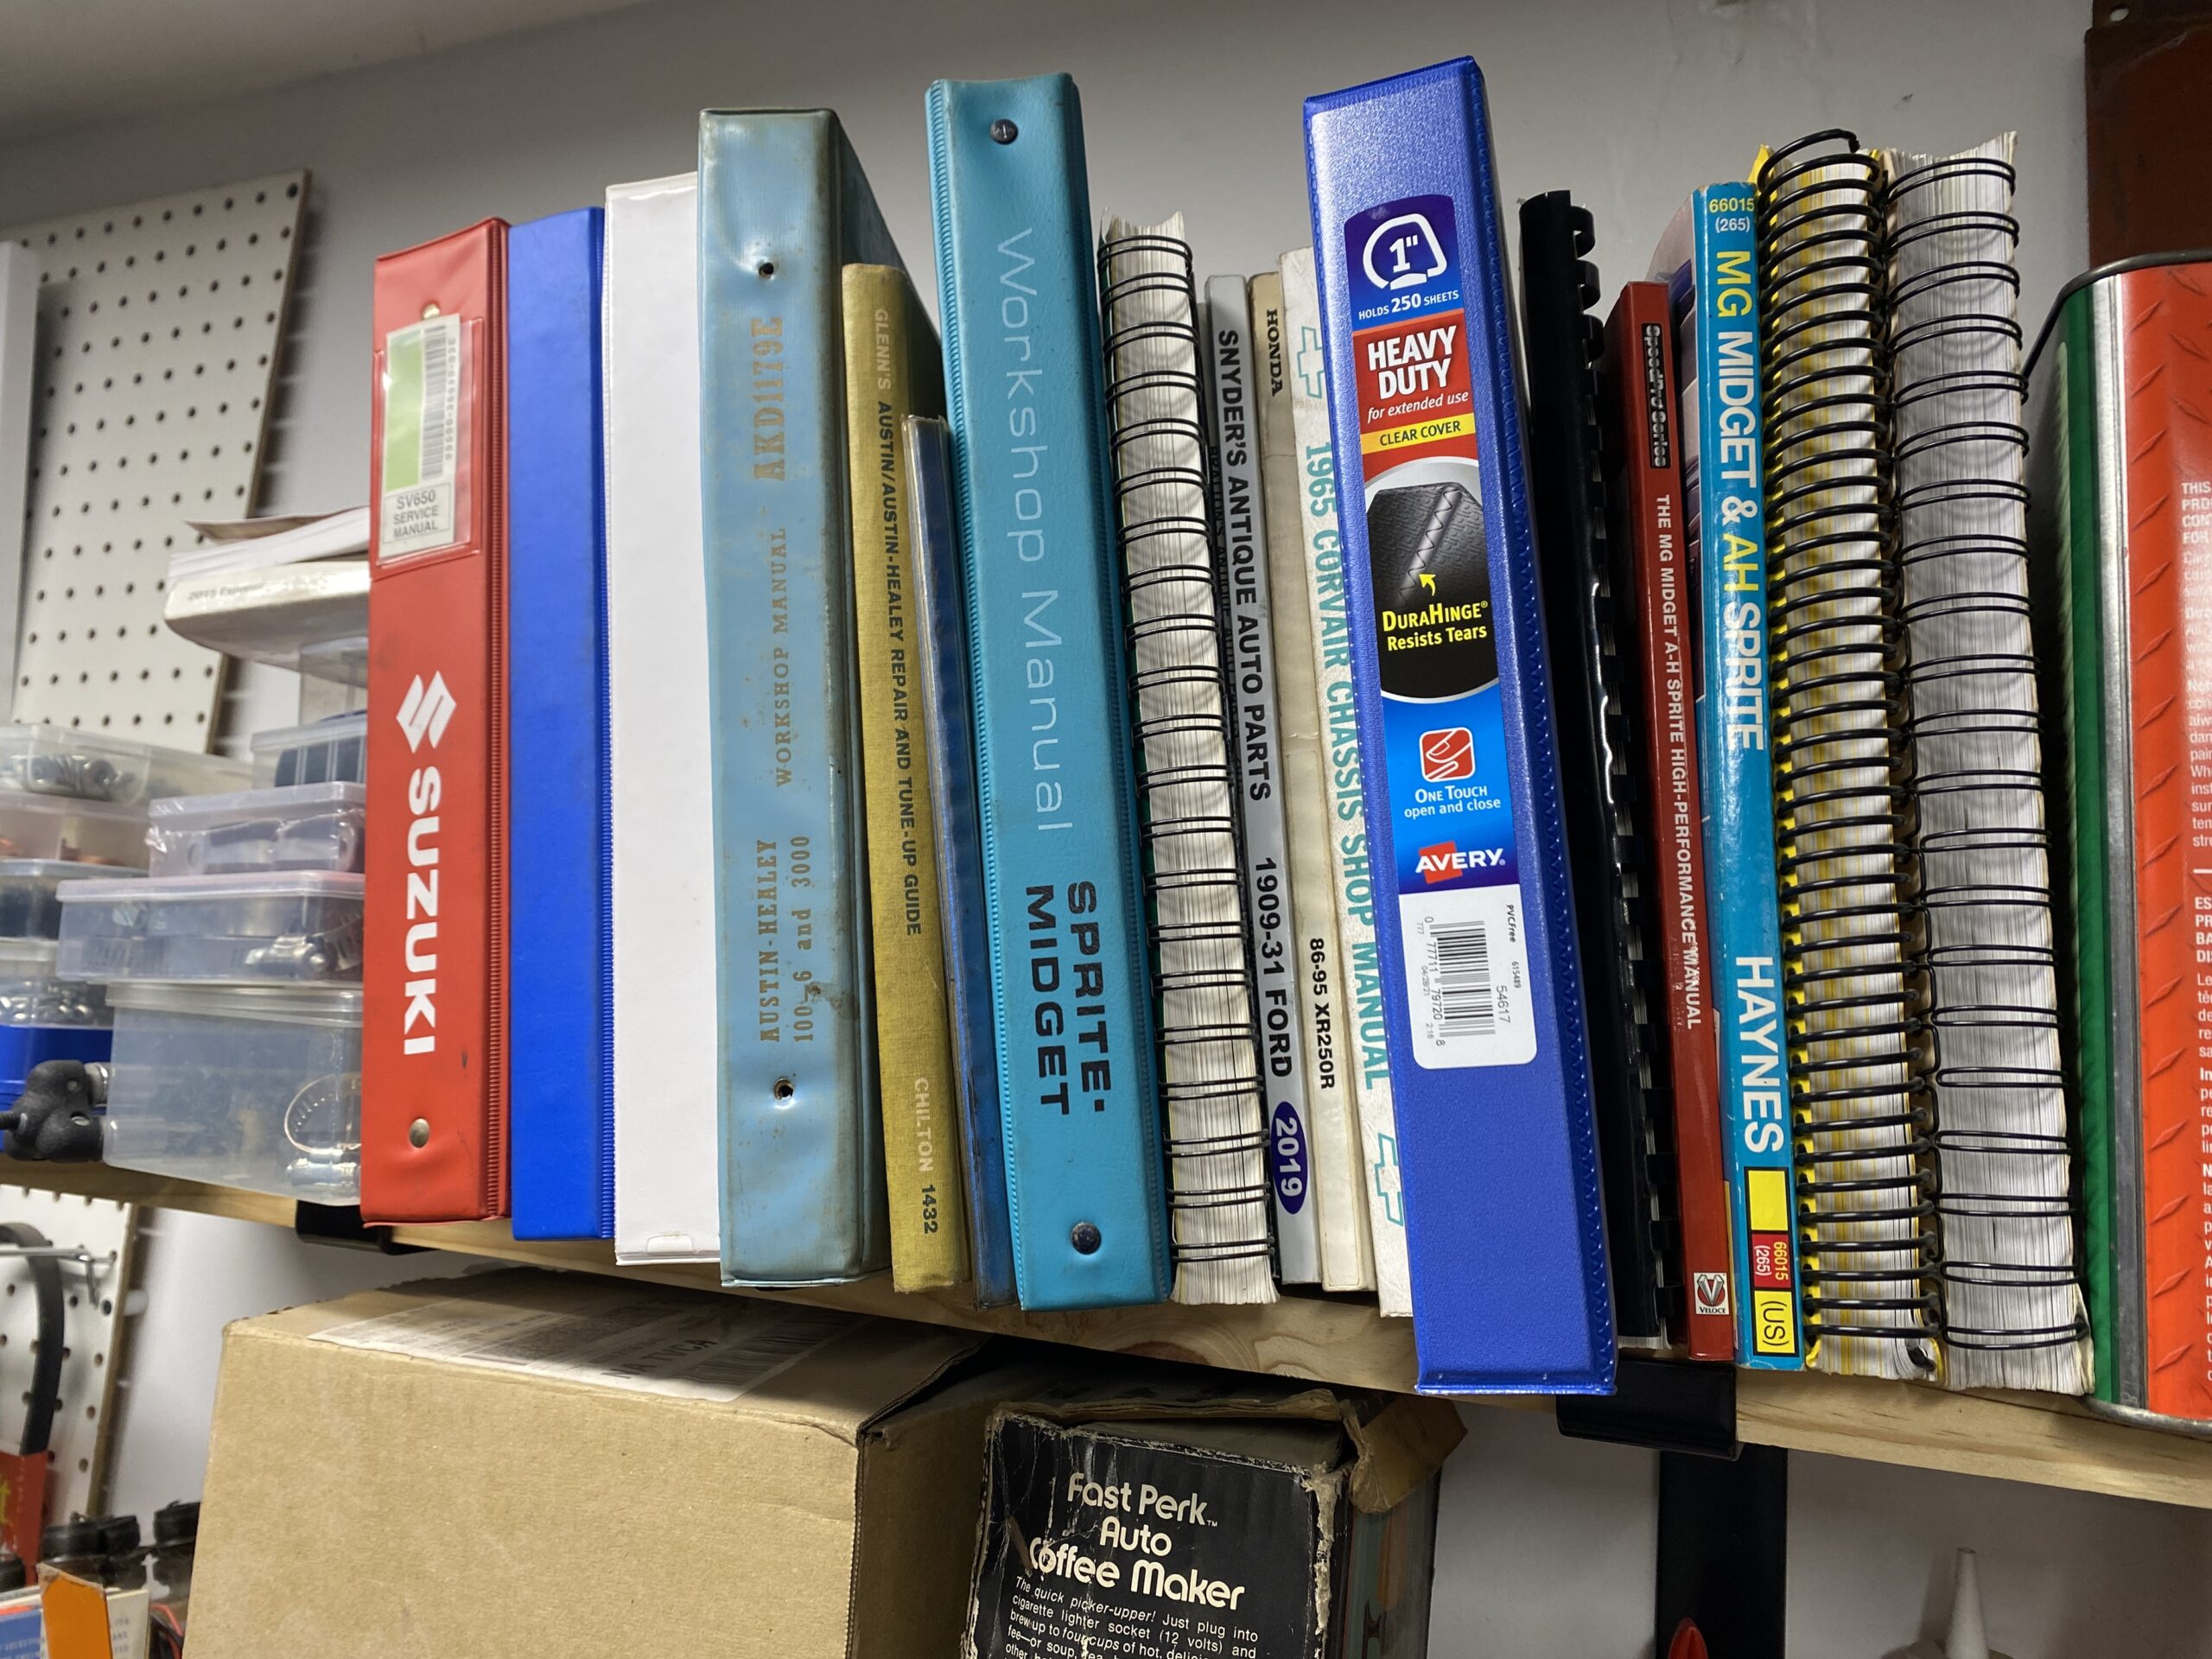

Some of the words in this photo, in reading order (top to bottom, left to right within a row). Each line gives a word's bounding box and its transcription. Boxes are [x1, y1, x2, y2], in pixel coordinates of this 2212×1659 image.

[1709, 197, 1755, 213] 66015
[1715, 217, 1750, 233] (265)
[1359, 306, 1389, 321] HOLDS
[1391, 293, 1421, 313] 250
[1424, 289, 1459, 306] SHEETS
[1716, 250, 1753, 319] MG
[874, 308, 892, 391] GLENN'S
[1266, 308, 1283, 397] HONDA
[1368, 325, 1457, 371] HEAVY
[1378, 358, 1451, 400] DUTY
[750, 316, 786, 482] AKD1179E
[998, 227, 1049, 563] Workshop
[1217, 329, 1247, 467] SNYDER'S
[1367, 406, 1385, 424] for
[1388, 393, 1443, 416] extended
[1446, 391, 1469, 406] use
[1718, 331, 1757, 489] MIDGET
[1380, 429, 1418, 447] CLEAR
[1421, 420, 1461, 438] COVER
[396, 489, 436, 510] SV650
[1306, 441, 1338, 518] 1965
[1656, 494, 1672, 529] THE
[1720, 495, 1758, 526] &
[2181, 480, 2211, 495] THIS
[393, 505, 439, 525] SERVICE
[394, 519, 438, 539] MANUAL
[878, 401, 905, 642] AUSTIN/AUSTIN-HEALEY
[1228, 475, 1257, 606] ANTIQUE
[1659, 534, 1674, 563] MG
[769, 527, 791, 635] MANUAL
[1722, 533, 1759, 592] AH
[1313, 529, 1350, 670] CORVAIR
[1660, 568, 1678, 637] MIDGET
[1236, 614, 1263, 695] AUTO
[1387, 632, 1443, 652] Resists
[1446, 624, 1488, 643] Tears
[1664, 641, 1680, 674] A-H
[890, 649, 908, 721] REPAIR
[1021, 589, 1074, 831] Manual
[1724, 601, 1765, 752] SPRITE
[773, 646, 793, 788] WORKSHOP
[1667, 677, 1684, 744] SPRITE
[894, 728, 912, 771] AND
[1244, 703, 1271, 802] PARTS
[1326, 680, 1364, 822] CHASSIS
[898, 777, 918, 867] TUNE-UP
[1404, 805, 1435, 820] open
[1440, 799, 1464, 815] and
[1466, 796, 1502, 811] close
[791, 836, 812, 888] 3000
[1340, 834, 1376, 927] SHOP
[1670, 747, 1697, 948] HIGH-PERFORMANCE
[404, 766, 442, 1056] SUZUKI
[791, 907, 812, 950] and
[902, 873, 921, 937] GUIDE
[1255, 856, 1287, 976] 1909-31
[756, 839, 780, 1043] AUSTIN-HEALEY
[1309, 938, 1329, 996] 86-95
[1026, 885, 1070, 1116] MIDGET
[1351, 941, 1390, 1091] MANUAL
[1433, 988, 1444, 1020] 79720
[1496, 985, 1511, 1024] 54617
[1682, 948, 1702, 1031] MANUAL
[1265, 988, 1294, 1079] FORD
[1314, 1002, 1336, 1090] XR250R
[1735, 956, 1785, 1154] HAYNES
[914, 1077, 934, 1173] CHILTON
[1274, 1116, 1304, 1198] 2019
[921, 1184, 939, 1235] 1432
[1753, 1244, 1771, 1276] (265)
[1773, 1240, 1789, 1281] 66015
[1759, 1299, 1788, 1347] (US)
[1067, 1472, 1132, 1513] Fast
[1099, 1516, 1173, 1556] Auto
[1029, 1536, 1121, 1588] Coffee
[1130, 1559, 1245, 1611] Maker
[1010, 1608, 1030, 1628] brew
[1031, 1619, 1046, 1636] up
[1048, 1624, 1060, 1637] to
[1089, 1635, 1120, 1651] cups
[1122, 1639, 1136, 1654] of
[1138, 1642, 1162, 1659] hot,
[1012, 1594, 1054, 1618] cigarette
[1060, 1608, 1100, 1630] lighter
[1108, 1622, 1151, 1640] socket
[1159, 1629, 1179, 1645] (12
[1187, 1637, 1224, 1655] volts)
[1231, 1645, 1257, 1659] and
[1015, 1576, 1032, 1593] The
[1033, 1585, 1065, 1604] quick
[1070, 1596, 1157, 1624] picker-upper!
[1162, 1613, 1190, 1630] Just
[1197, 1619, 1226, 1639] plug
[1233, 1626, 1259, 1643] into
[1005, 1643, 1028, 1659] other
[1046, 1641, 1077, 1659] soup,
